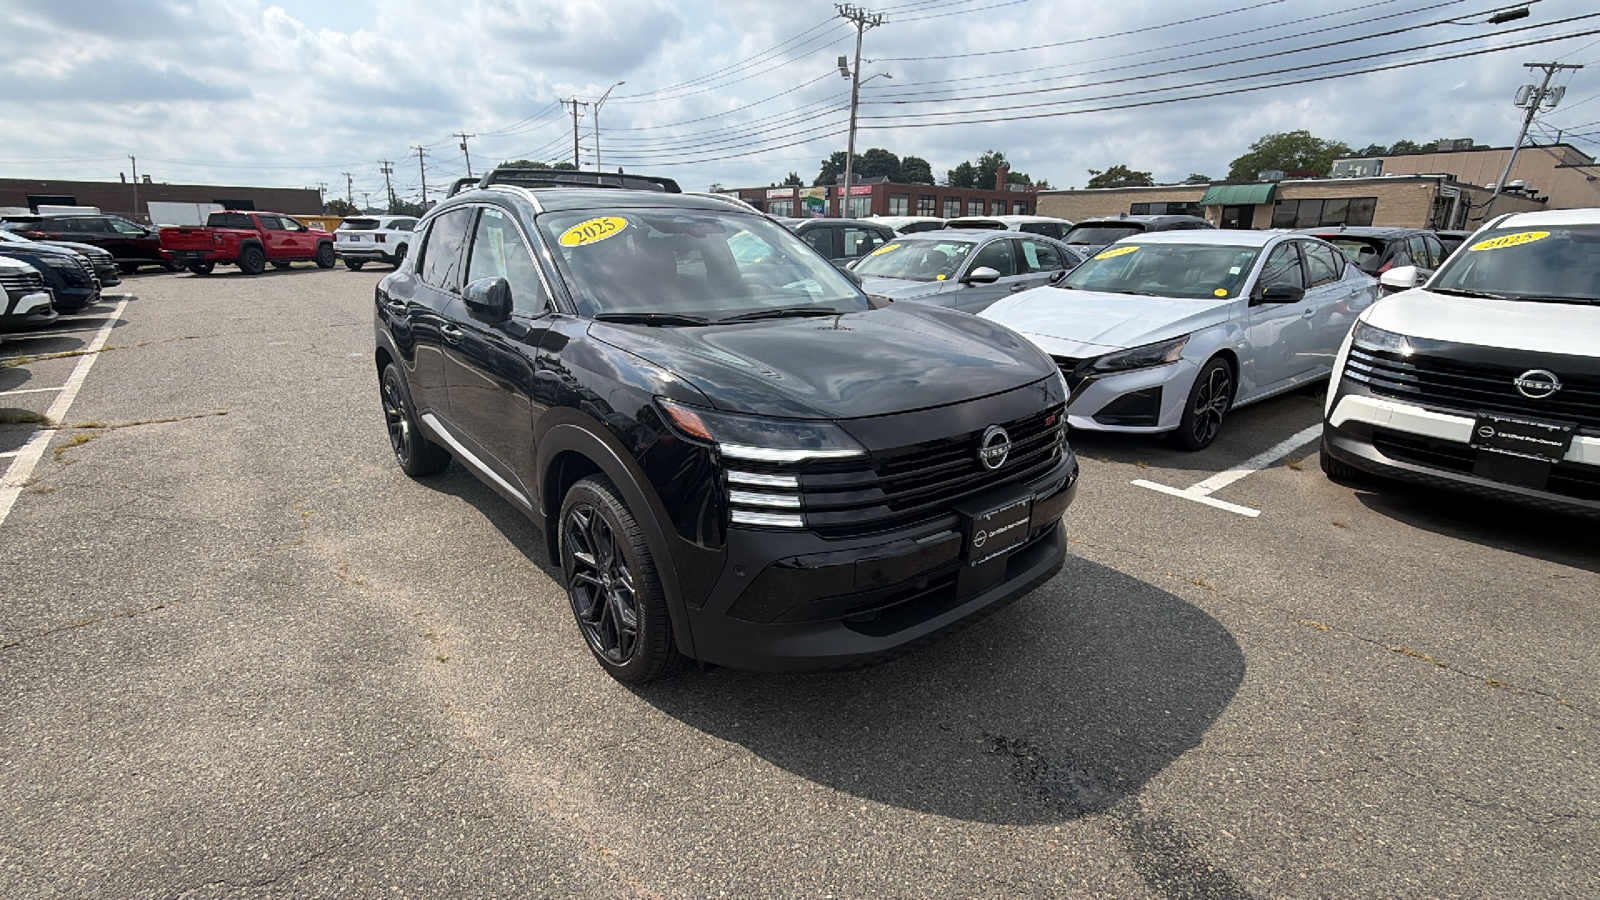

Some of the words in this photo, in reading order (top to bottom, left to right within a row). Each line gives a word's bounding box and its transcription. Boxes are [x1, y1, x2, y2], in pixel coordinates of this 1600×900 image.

[572, 218, 616, 243] 2025
[1484, 233, 1534, 249] 2025
[1514, 379, 1562, 391] NISSAN
[1497, 432, 1525, 440] Certified
[980, 442, 1012, 458] NISSAN
